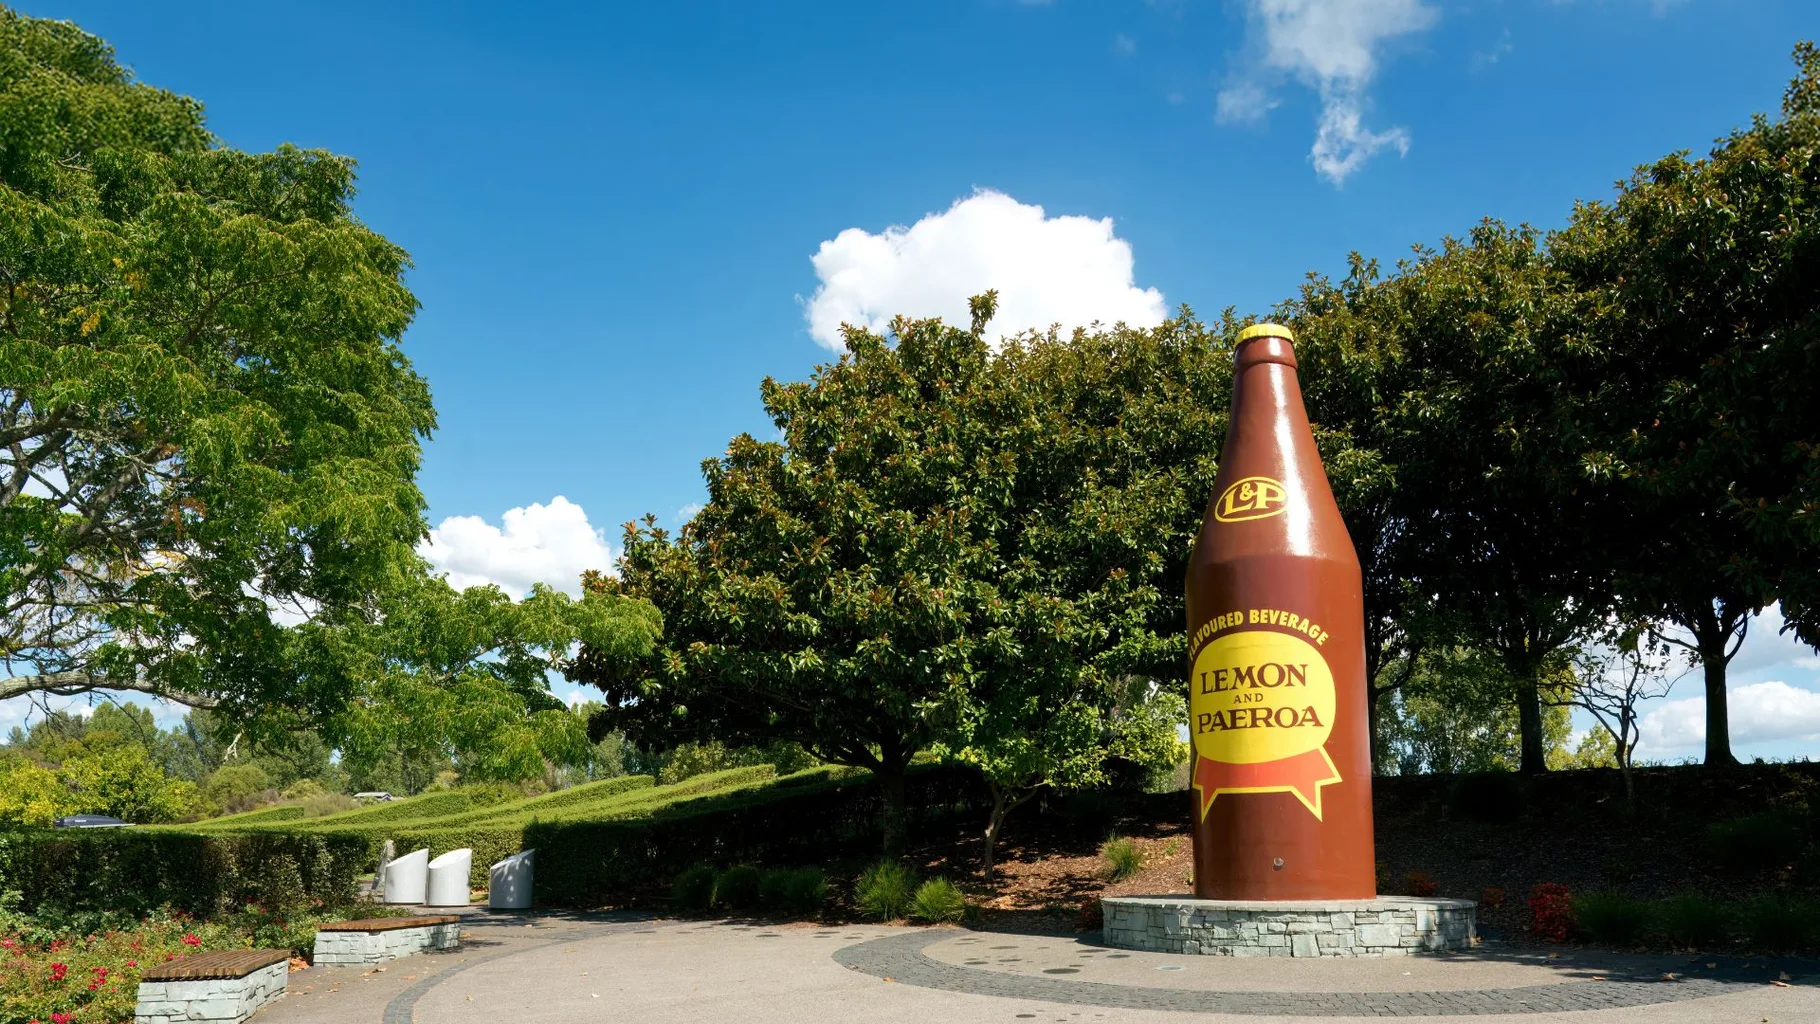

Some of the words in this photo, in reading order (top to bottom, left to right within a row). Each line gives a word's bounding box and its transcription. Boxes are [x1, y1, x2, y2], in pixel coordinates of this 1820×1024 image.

[1222, 481, 1286, 516] L&P
[1249, 609, 1329, 646] BEVERAGE
[1200, 663, 1308, 694] LEMON
[1233, 693, 1264, 704] AND
[1198, 705, 1324, 734] PAEROA
